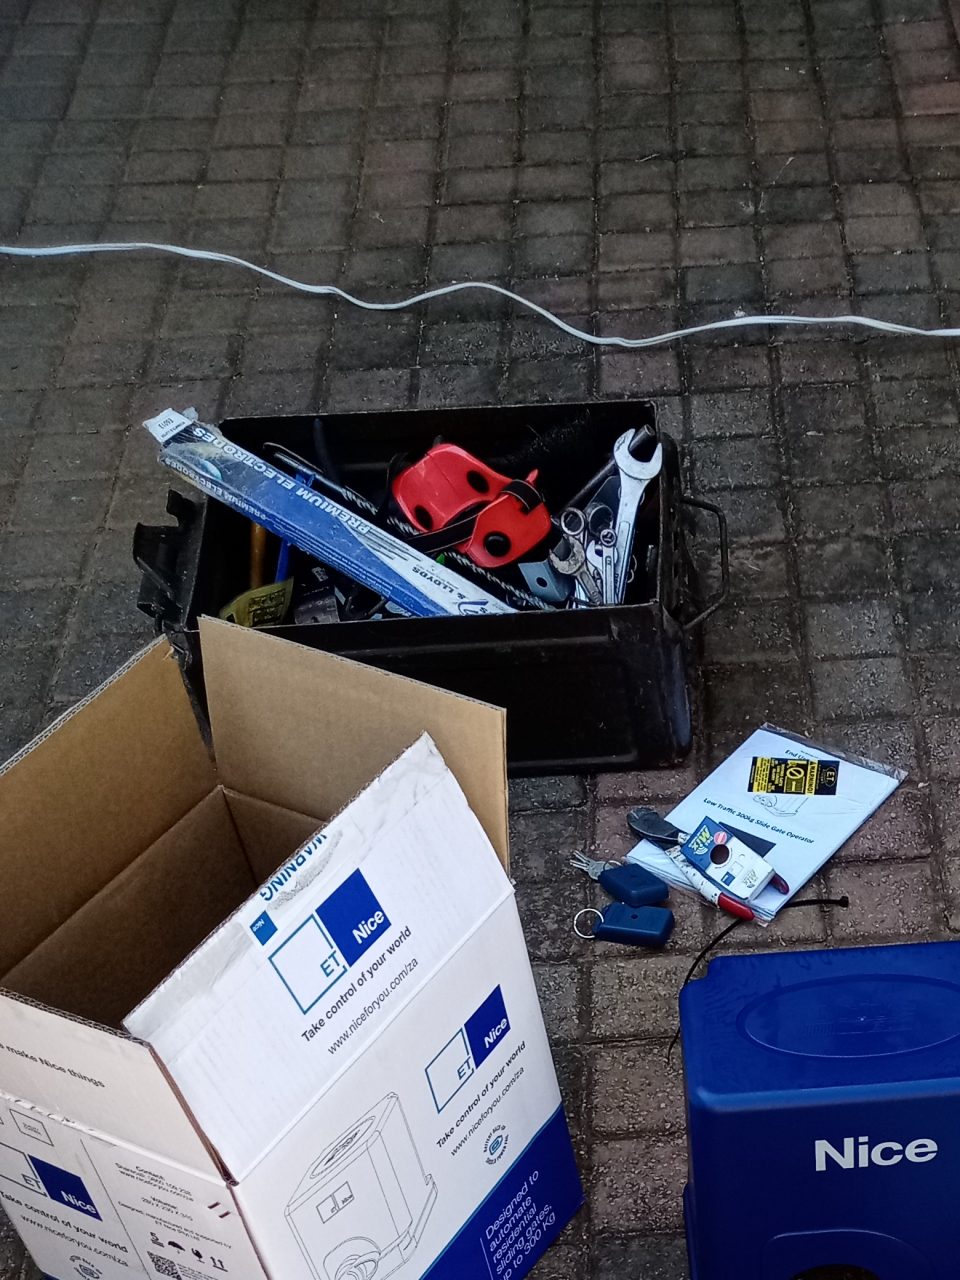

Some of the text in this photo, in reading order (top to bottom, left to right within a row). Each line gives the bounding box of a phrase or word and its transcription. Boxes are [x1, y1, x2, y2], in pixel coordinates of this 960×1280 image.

[163, 457, 266, 519] PREMIUM ELECTRODES
[191, 424, 371, 535] PREMIUM ELECTRODES
[411, 565, 454, 593] LLOYDS
[703, 797, 814, 844] Low Traffic 300kg Slide Gate Operator
[319, 906, 385, 978] ET Nice
[301, 924, 413, 1043] Take control of your world
[326, 954, 420, 1057] www.niceforyou.com/za
[37, 1057, 67, 1073] Nice
[65, 1068, 106, 1089] things
[456, 1013, 508, 1081] ET Nice
[436, 1038, 526, 1150] Take control of your world
[450, 1063, 525, 1158] www.niceforyou.com/za
[814, 1136, 938, 1171] Nice
[21, 1174, 96, 1214] ET Nice
[485, 1167, 539, 1241] Designed to
[488, 1193, 532, 1252] automate
[25, 1203, 60, 1224] control
[61, 1220, 72, 1229] of
[73, 1225, 96, 1238] your
[99, 1236, 128, 1253] world
[491, 1202, 536, 1265] residential
[494, 1231, 526, 1276] sliding
[512, 1250, 523, 1269] to
[522, 1227, 542, 1257] 300
[541, 1209, 556, 1235] Kg
